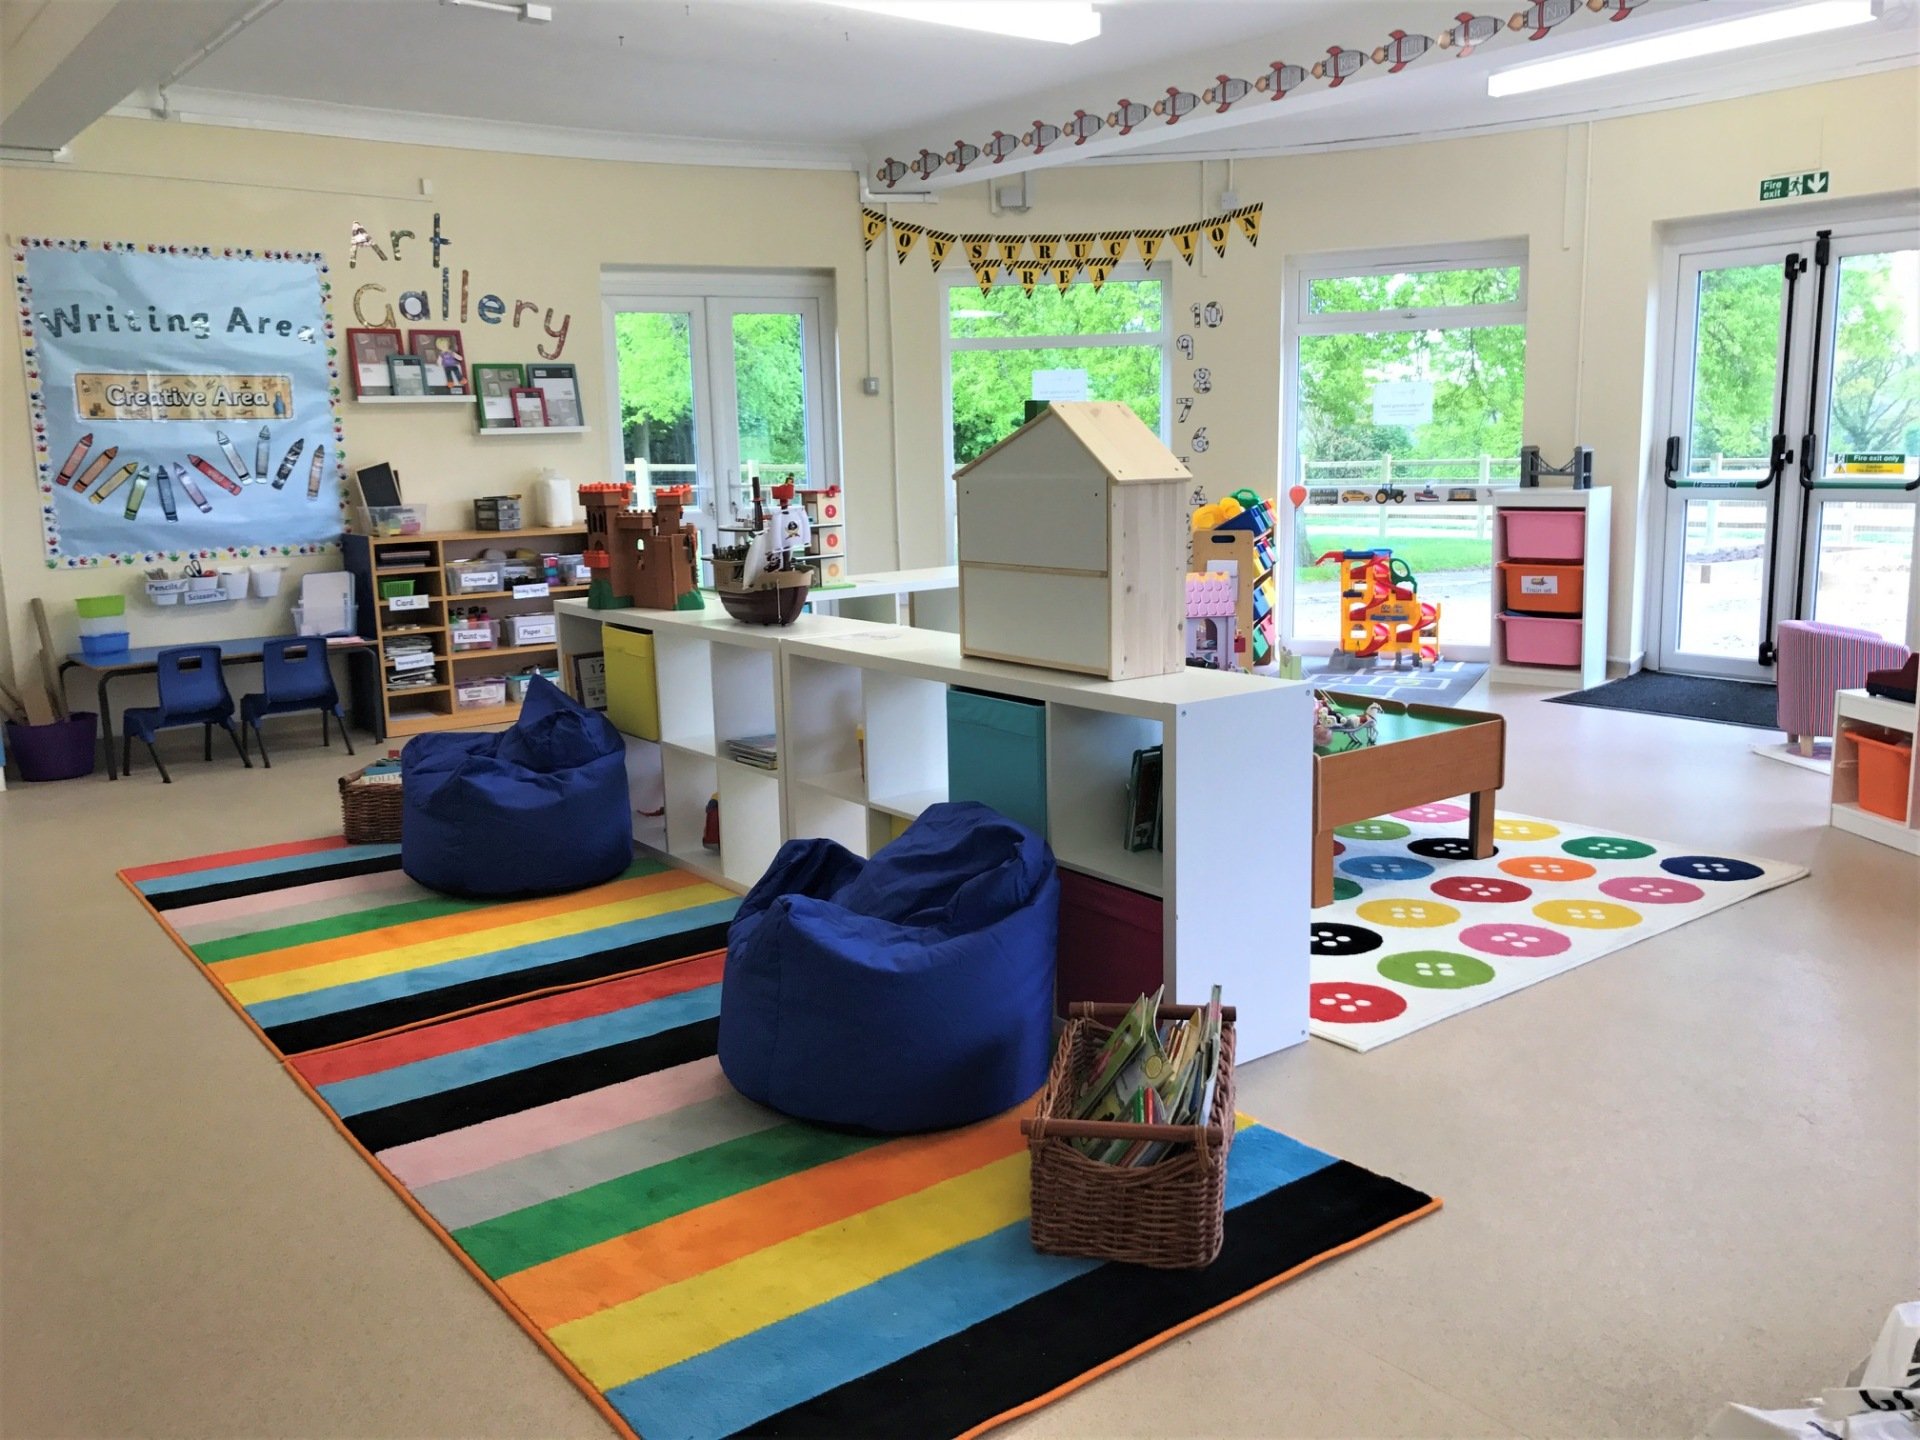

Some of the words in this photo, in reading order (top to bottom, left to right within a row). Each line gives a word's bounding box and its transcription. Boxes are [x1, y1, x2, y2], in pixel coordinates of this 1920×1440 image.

[1763, 181, 1782, 190] Fire
[1763, 189, 1781, 198] exit
[350, 213, 451, 268] Art
[866, 214, 1257, 261] CONSTRUCTION
[980, 267, 1105, 285] AREA
[39, 304, 211, 339] Writing
[226, 307, 316, 344] Area
[353, 267, 571, 360] Gallery
[1190, 301, 1224, 328] 10
[1176, 334, 1194, 360] 9
[1192, 367, 1212, 394] 8
[106, 384, 206, 407] Creative
[212, 386, 269, 407] Area
[1176, 397, 1194, 423] 7
[1191, 427, 1209, 453] 6
[1853, 454, 1868, 462] Fire
[1884, 455, 1900, 463] only
[1189, 485, 1207, 507] 4
[149, 583, 178, 592] Pencils
[188, 592, 218, 601] Scissors
[395, 599, 415, 607] Card
[458, 632, 477, 640] Paint
[522, 629, 541, 637] Paper
